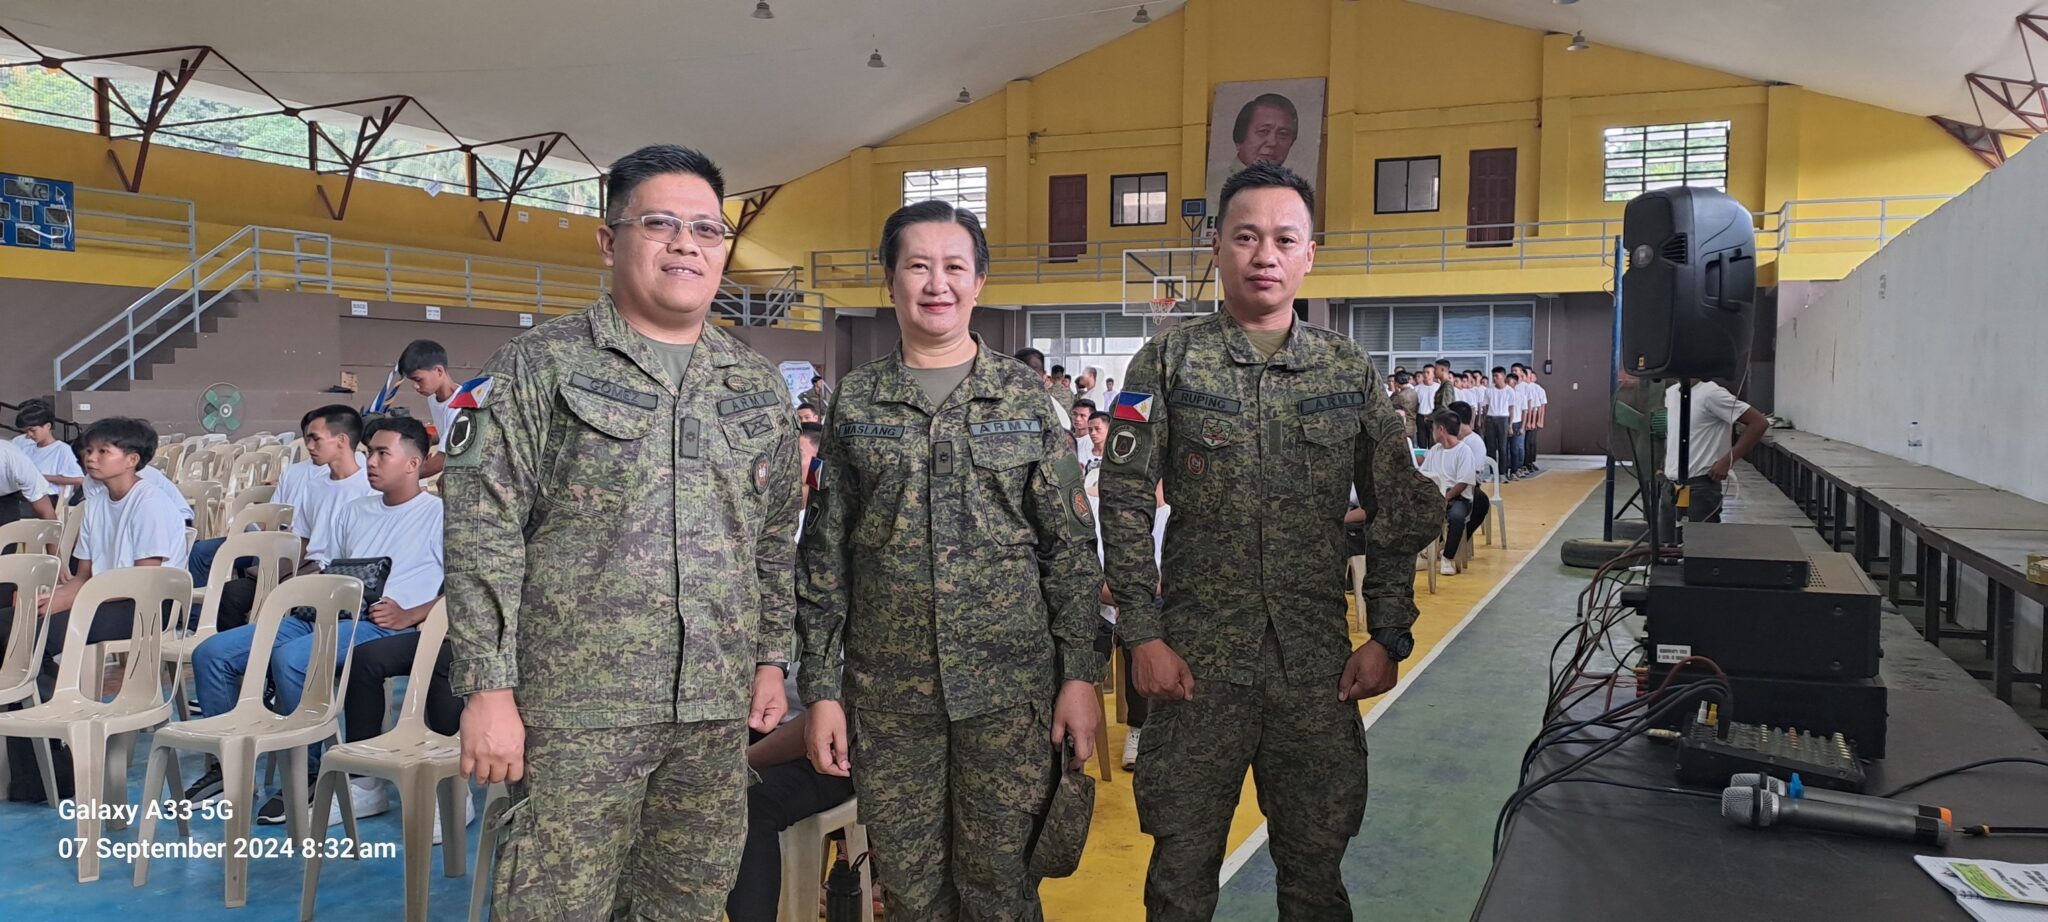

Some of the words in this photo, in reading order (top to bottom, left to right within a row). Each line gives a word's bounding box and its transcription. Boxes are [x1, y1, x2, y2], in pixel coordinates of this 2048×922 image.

[590, 380, 640, 401] GOMEZ
[732, 393, 767, 410] ARMY
[1181, 392, 1226, 409] RUPING
[1316, 394, 1355, 408] ARMY
[844, 425, 896, 435] MASLANG
[980, 421, 1032, 433] ARMY
